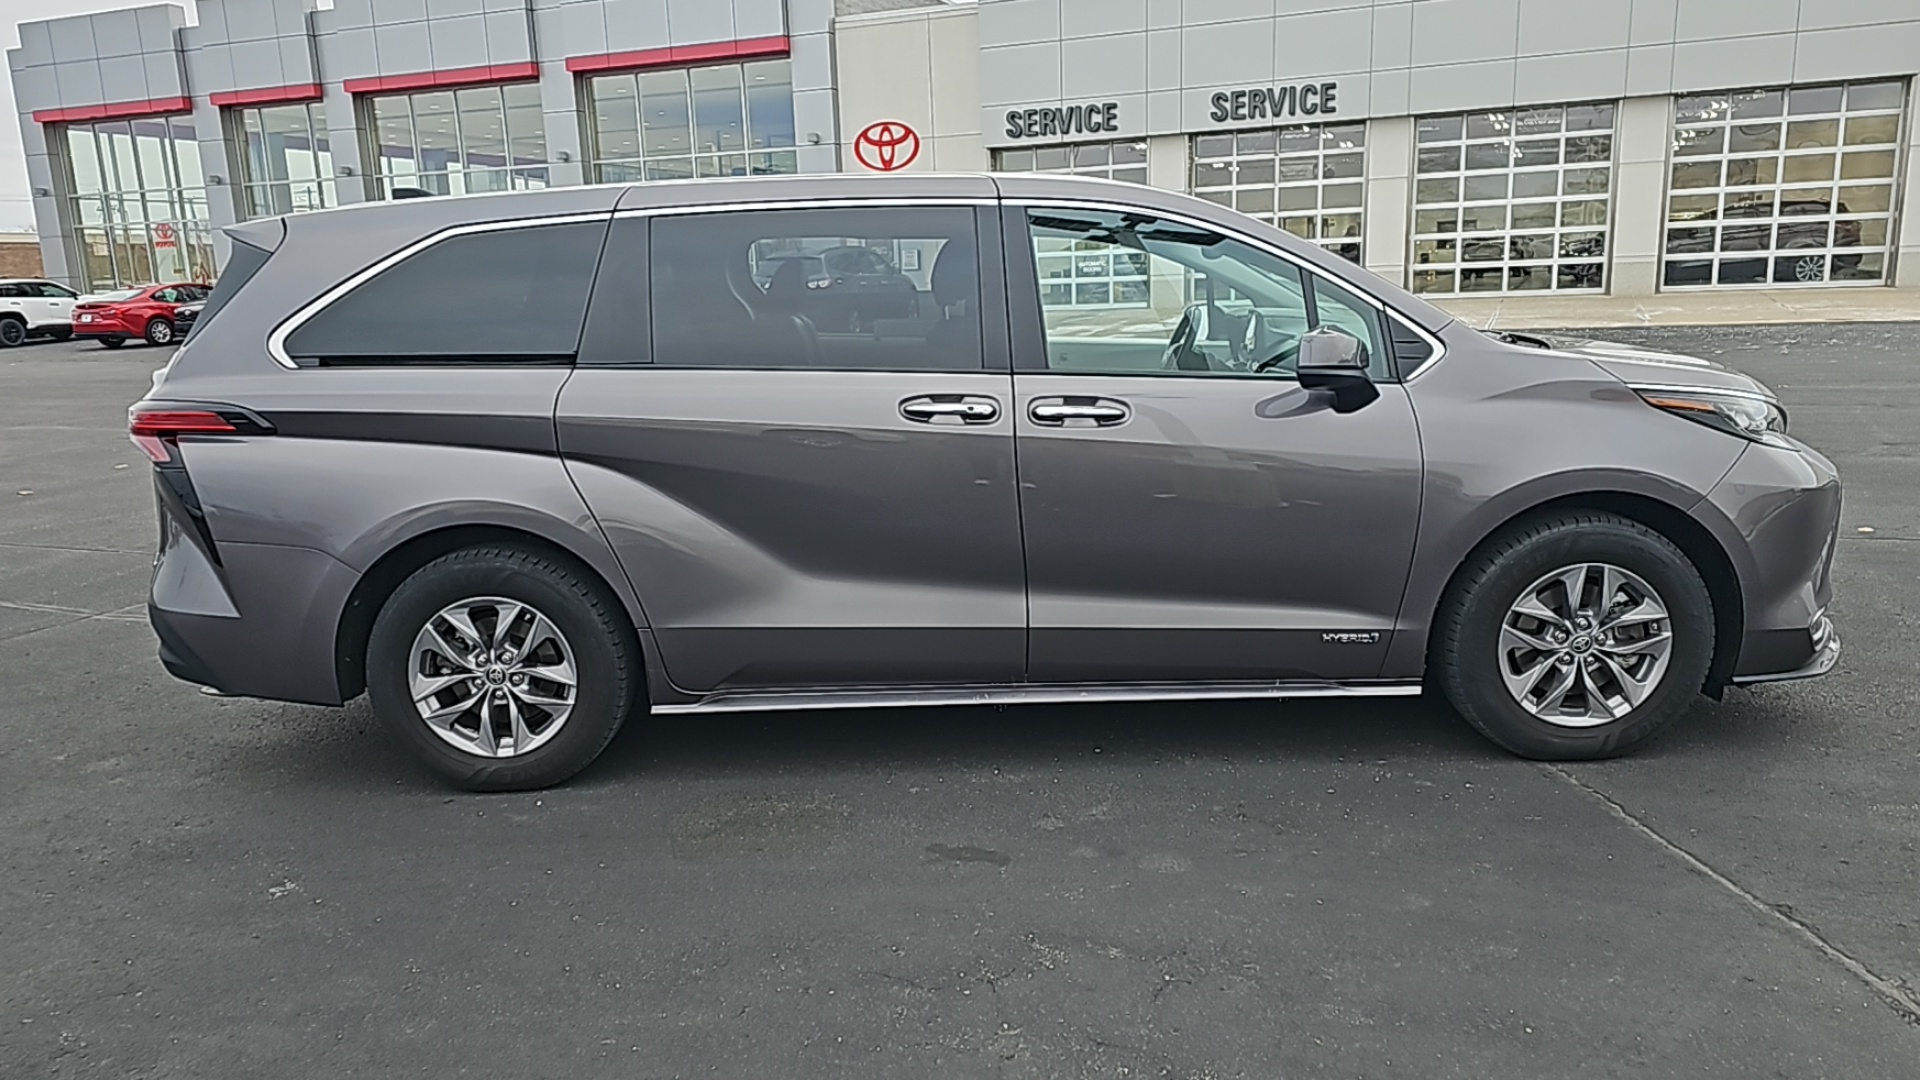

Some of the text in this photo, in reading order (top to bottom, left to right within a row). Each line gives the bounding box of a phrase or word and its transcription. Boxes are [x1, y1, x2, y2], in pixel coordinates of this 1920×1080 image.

[1210, 83, 1336, 122] SERVICE
[1006, 103, 1118, 138] SERVICE
[1322, 633, 1371, 643] HYBRID
